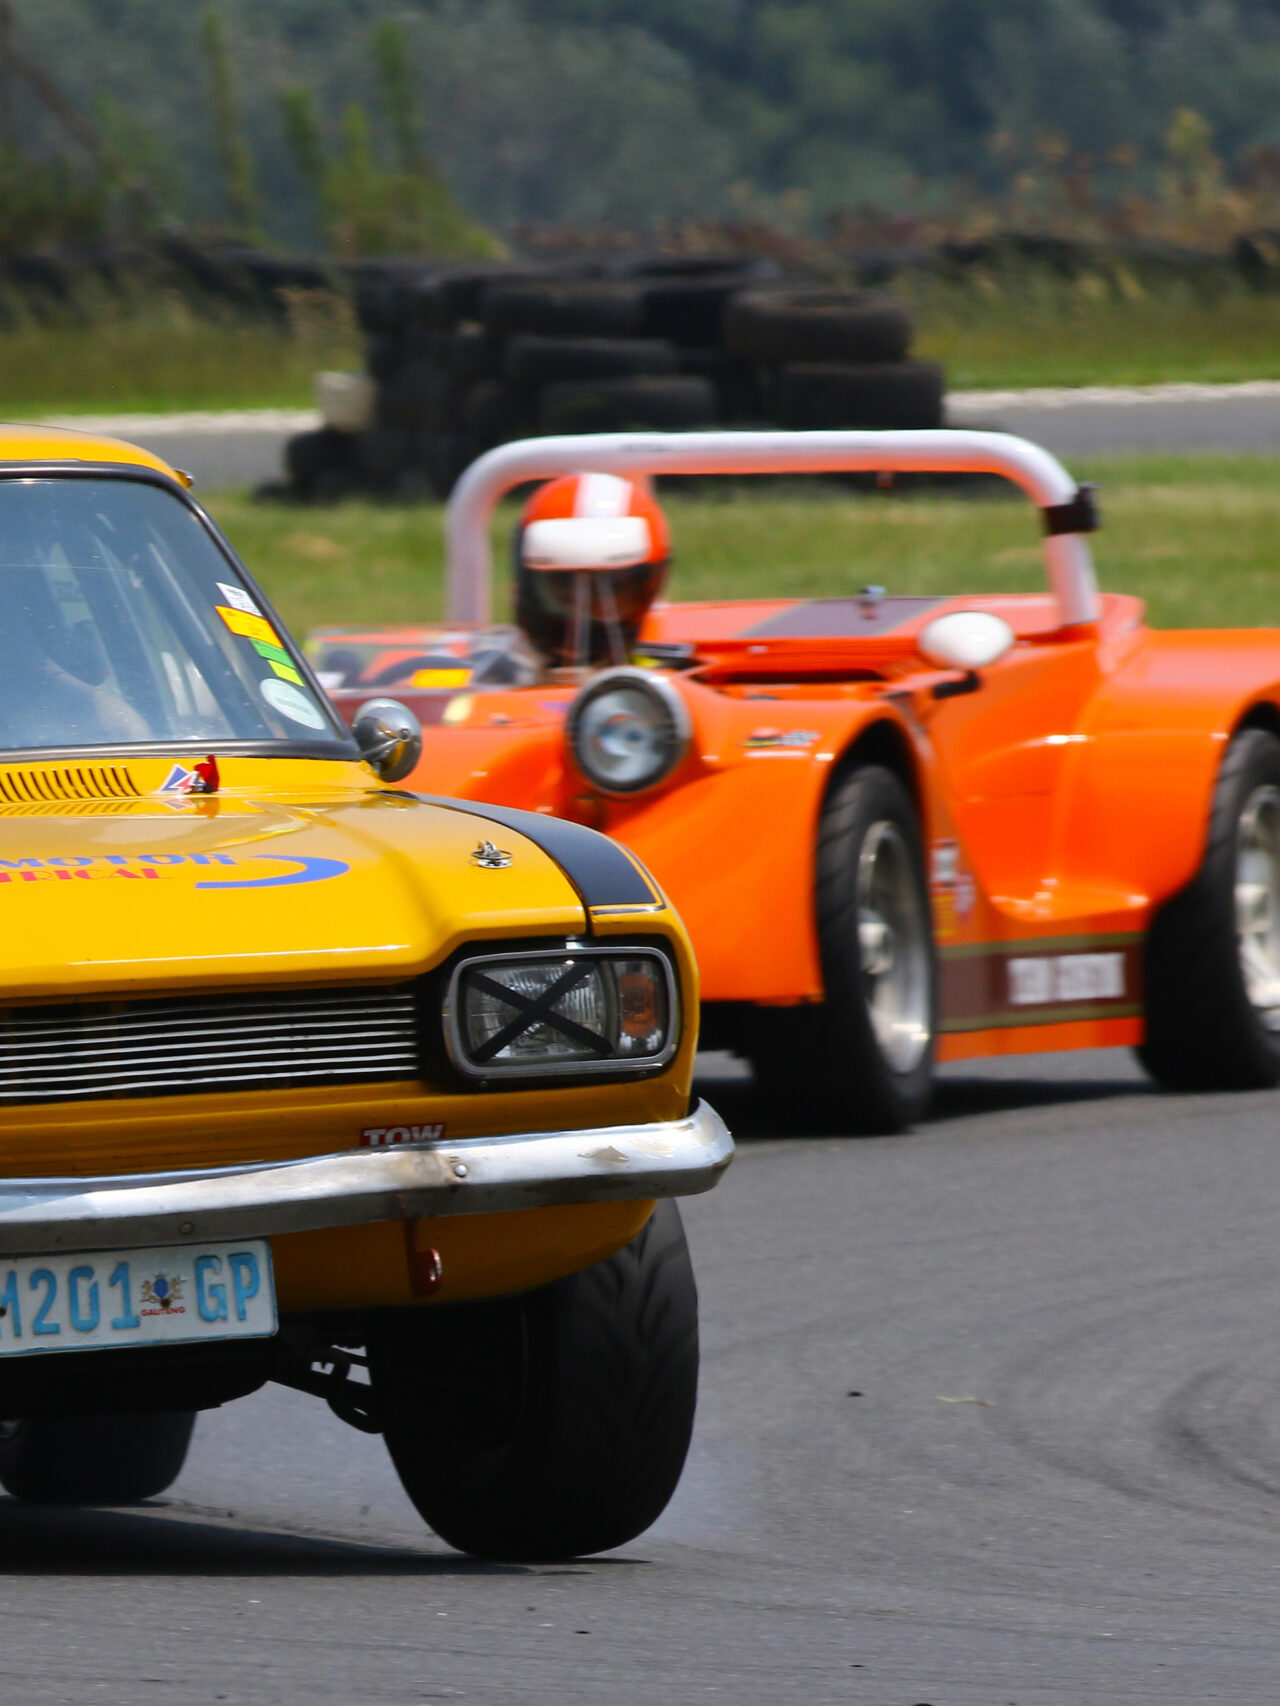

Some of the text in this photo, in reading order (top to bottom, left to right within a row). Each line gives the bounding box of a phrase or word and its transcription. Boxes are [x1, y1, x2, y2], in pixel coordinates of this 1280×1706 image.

[363, 1124, 446, 1145] TOW
[194, 1252, 261, 1323] GP
[140, 1306, 186, 1317] GAUTENG
